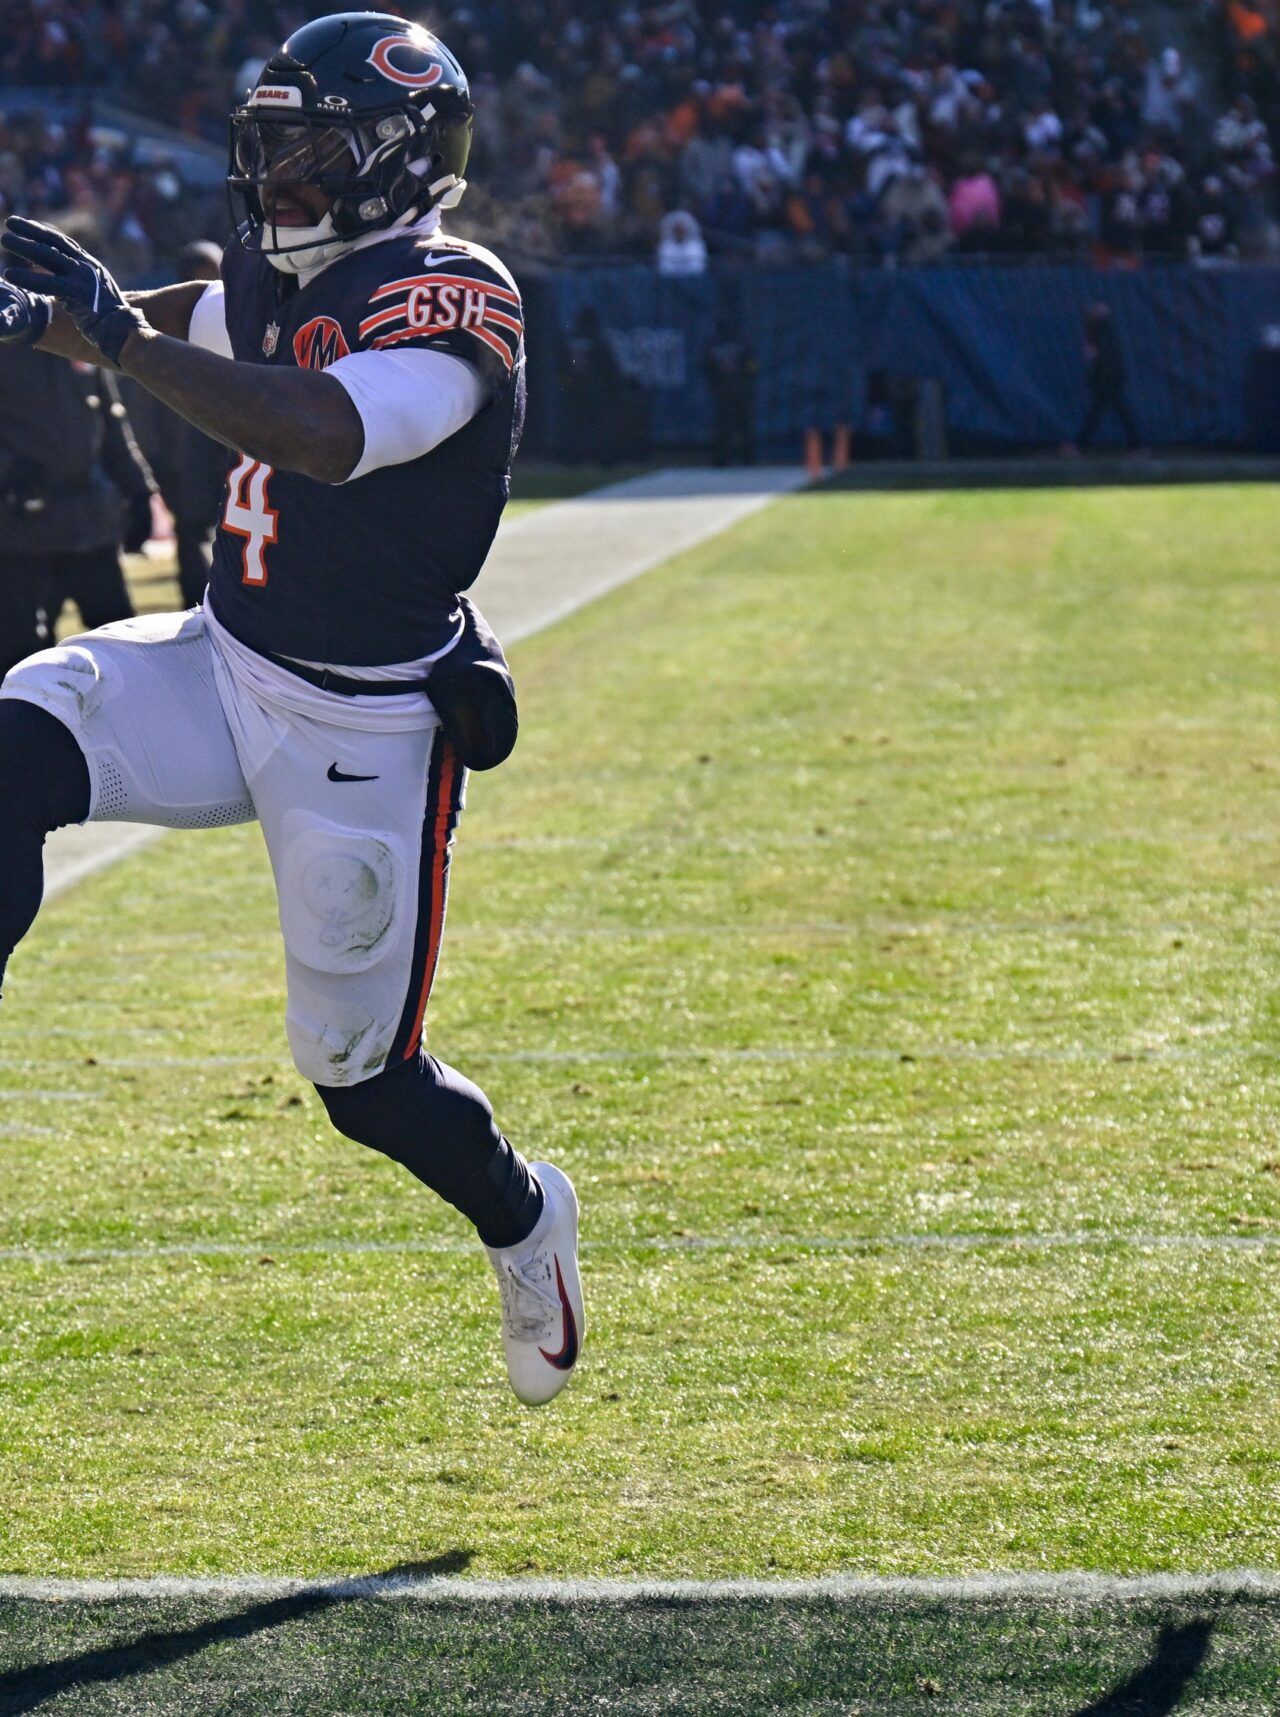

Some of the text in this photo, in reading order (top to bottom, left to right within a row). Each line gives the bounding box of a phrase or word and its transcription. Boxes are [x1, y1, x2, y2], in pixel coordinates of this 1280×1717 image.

[256, 90, 290, 100] BEARS
[317, 103, 353, 114] OAKLEY
[407, 284, 488, 329] GSH
[221, 452, 279, 587] 4
